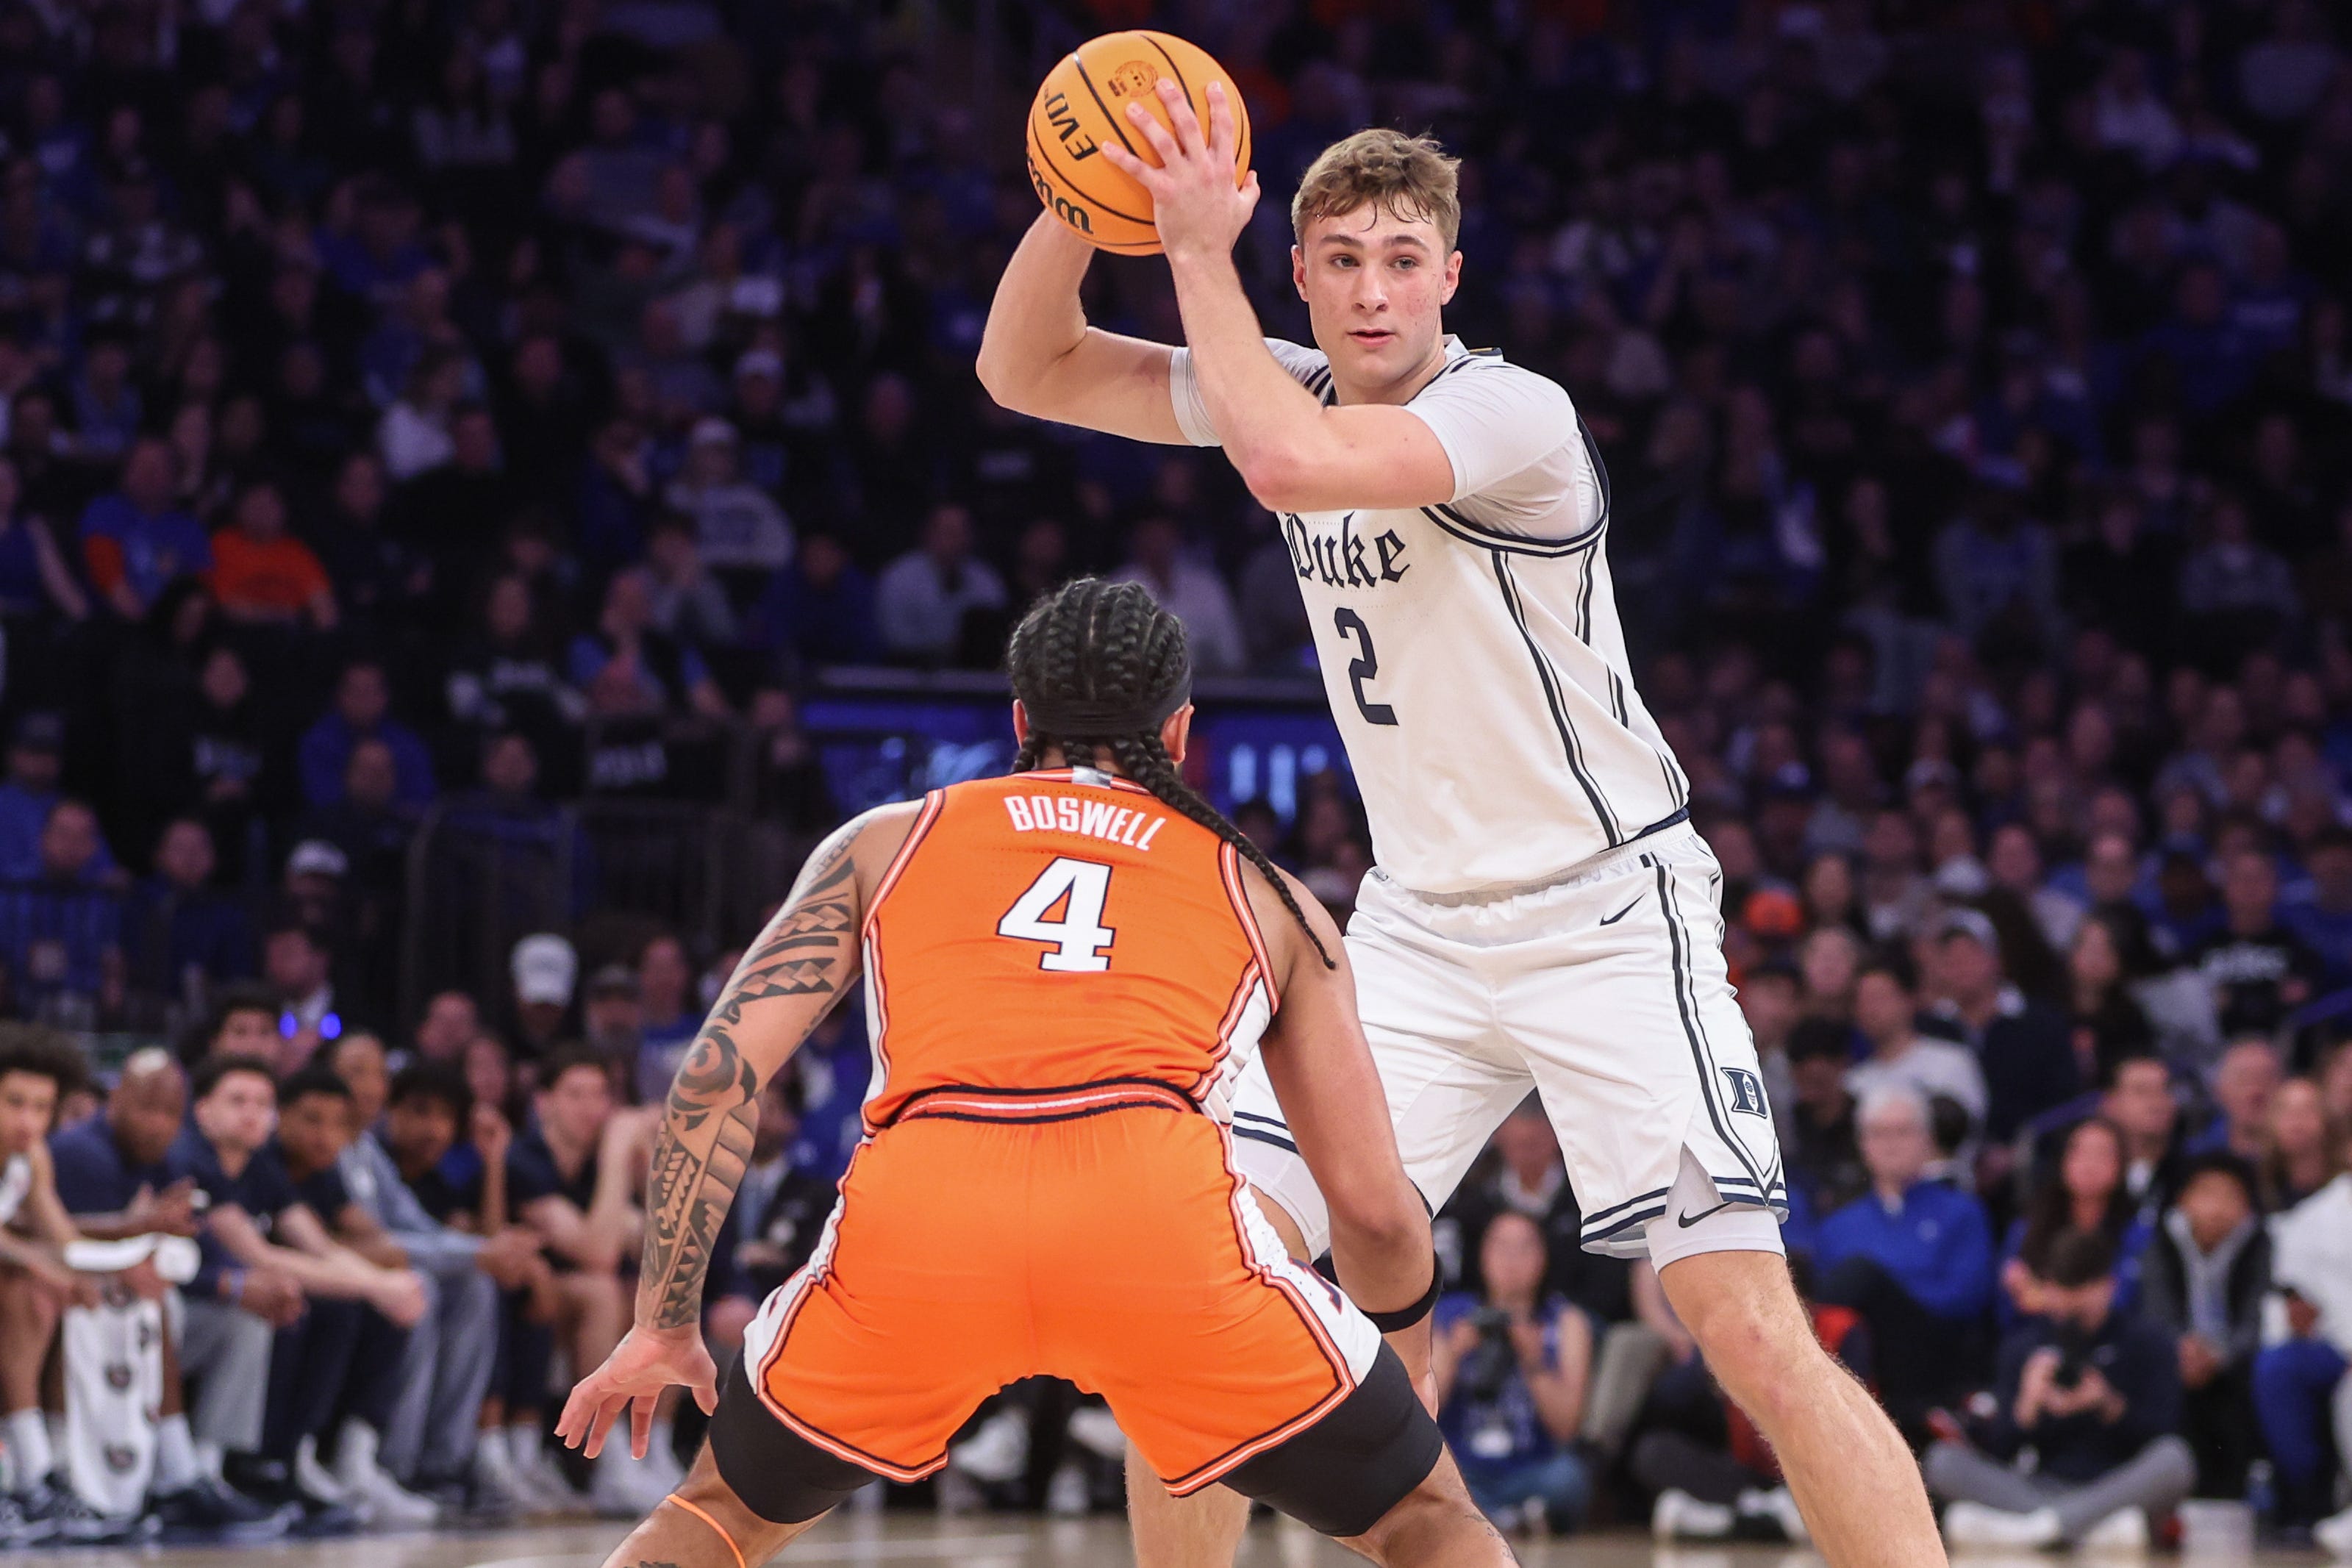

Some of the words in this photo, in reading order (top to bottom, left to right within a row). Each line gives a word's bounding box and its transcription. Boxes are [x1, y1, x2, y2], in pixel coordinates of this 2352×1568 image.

[1284, 510, 1411, 589] Duke
[1334, 606, 1400, 726] 2
[1004, 795, 1167, 851] BOSWELL
[996, 856, 1117, 973] 4
